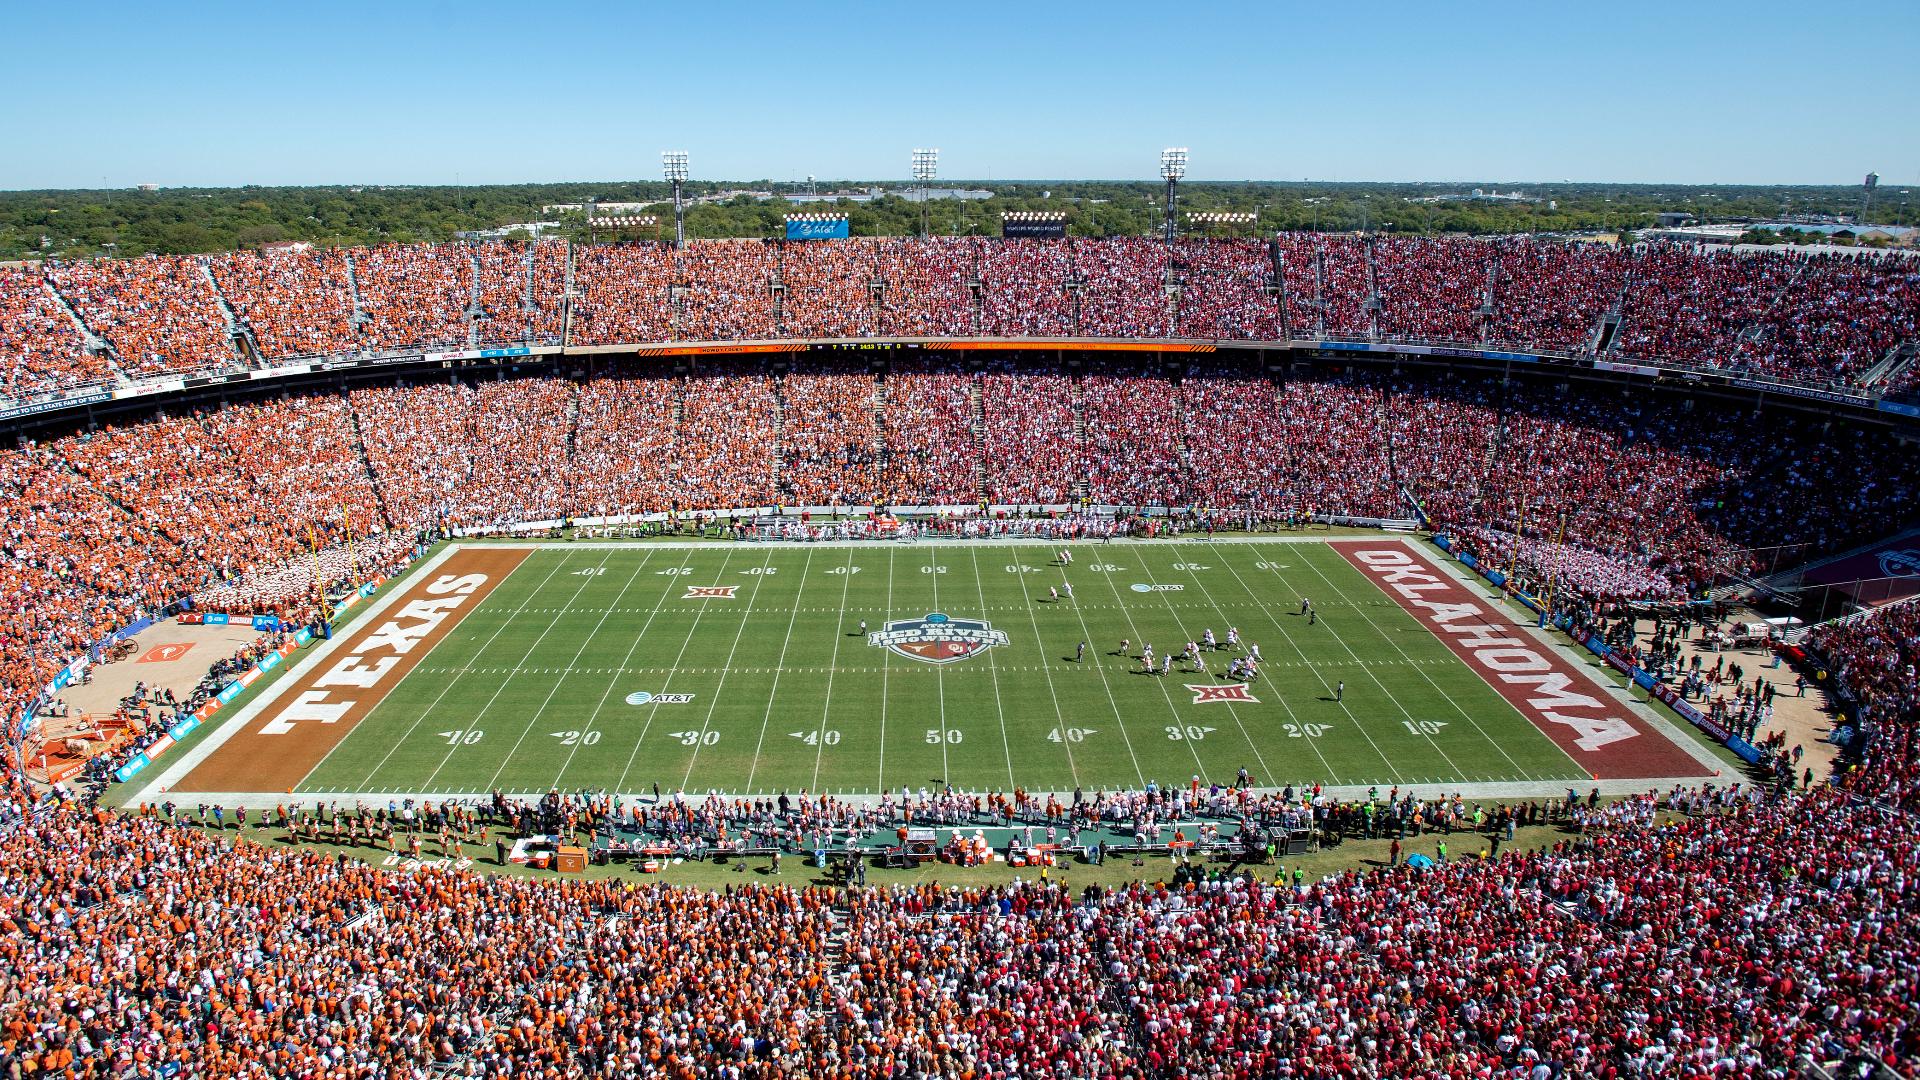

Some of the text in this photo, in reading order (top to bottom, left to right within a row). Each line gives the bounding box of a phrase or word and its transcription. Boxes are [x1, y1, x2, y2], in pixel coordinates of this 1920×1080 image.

[814, 225, 835, 234] AT&T
[208, 376, 228, 384] Jeep
[1682, 372, 1702, 381] Jeep
[1734, 379, 1768, 390] WELCOME
[1780, 386, 1793, 394] THE
[1794, 388, 1815, 398] STATE
[1815, 392, 1832, 400] FAIR
[43, 401, 63, 410] STATE
[63, 399, 77, 407] FAIR
[581, 567, 608, 575] 10
[666, 567, 694, 575] 20
[750, 567, 777, 575] 30
[835, 567, 862, 575] 40
[921, 566, 947, 574] 50
[1006, 565, 1032, 573] 40
[1089, 564, 1117, 572] 30
[1172, 563, 1200, 571] 20
[1255, 561, 1281, 570] 10
[870, 628, 1010, 645] RED RIVER
[880, 635, 996, 647] SHOWDOWN
[948, 643, 964, 652] OU
[1353, 549, 1642, 752] OKLAHOMA
[257, 573, 489, 735] TEXAS
[652, 693, 694, 703] AT&T
[1191, 685, 1257, 701] XII
[1164, 725, 1206, 741] 30
[1282, 723, 1323, 737] 20
[1401, 720, 1441, 735] 10
[1700, 718, 1730, 740] SOONERS
[445, 730, 485, 746] 10
[560, 730, 602, 746] 20
[681, 730, 720, 746] 30
[803, 730, 841, 746] 40
[925, 729, 963, 745] 50
[1046, 728, 1085, 743] 40
